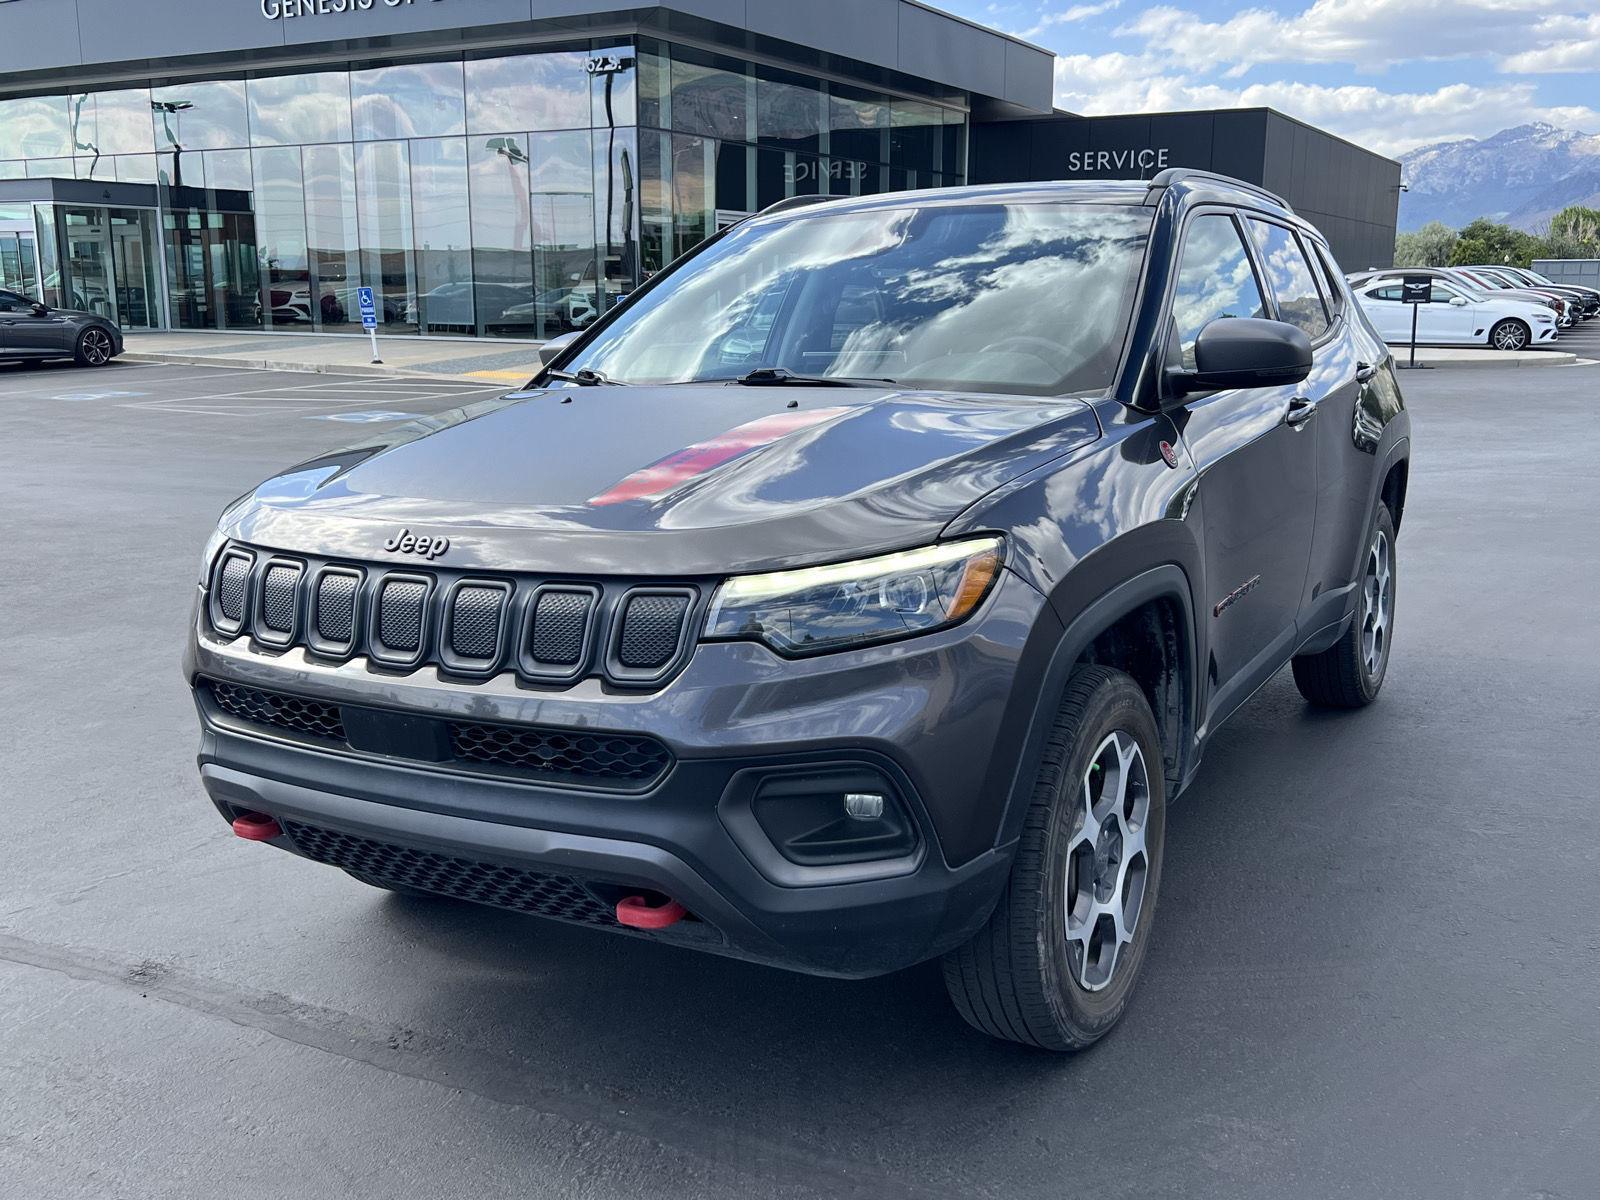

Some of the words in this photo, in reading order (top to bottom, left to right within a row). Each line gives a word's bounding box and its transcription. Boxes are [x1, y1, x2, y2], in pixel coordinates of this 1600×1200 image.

[578, 56, 603, 72] 62
[1068, 149, 1169, 171] SERVICE
[384, 528, 450, 560] Jeep
